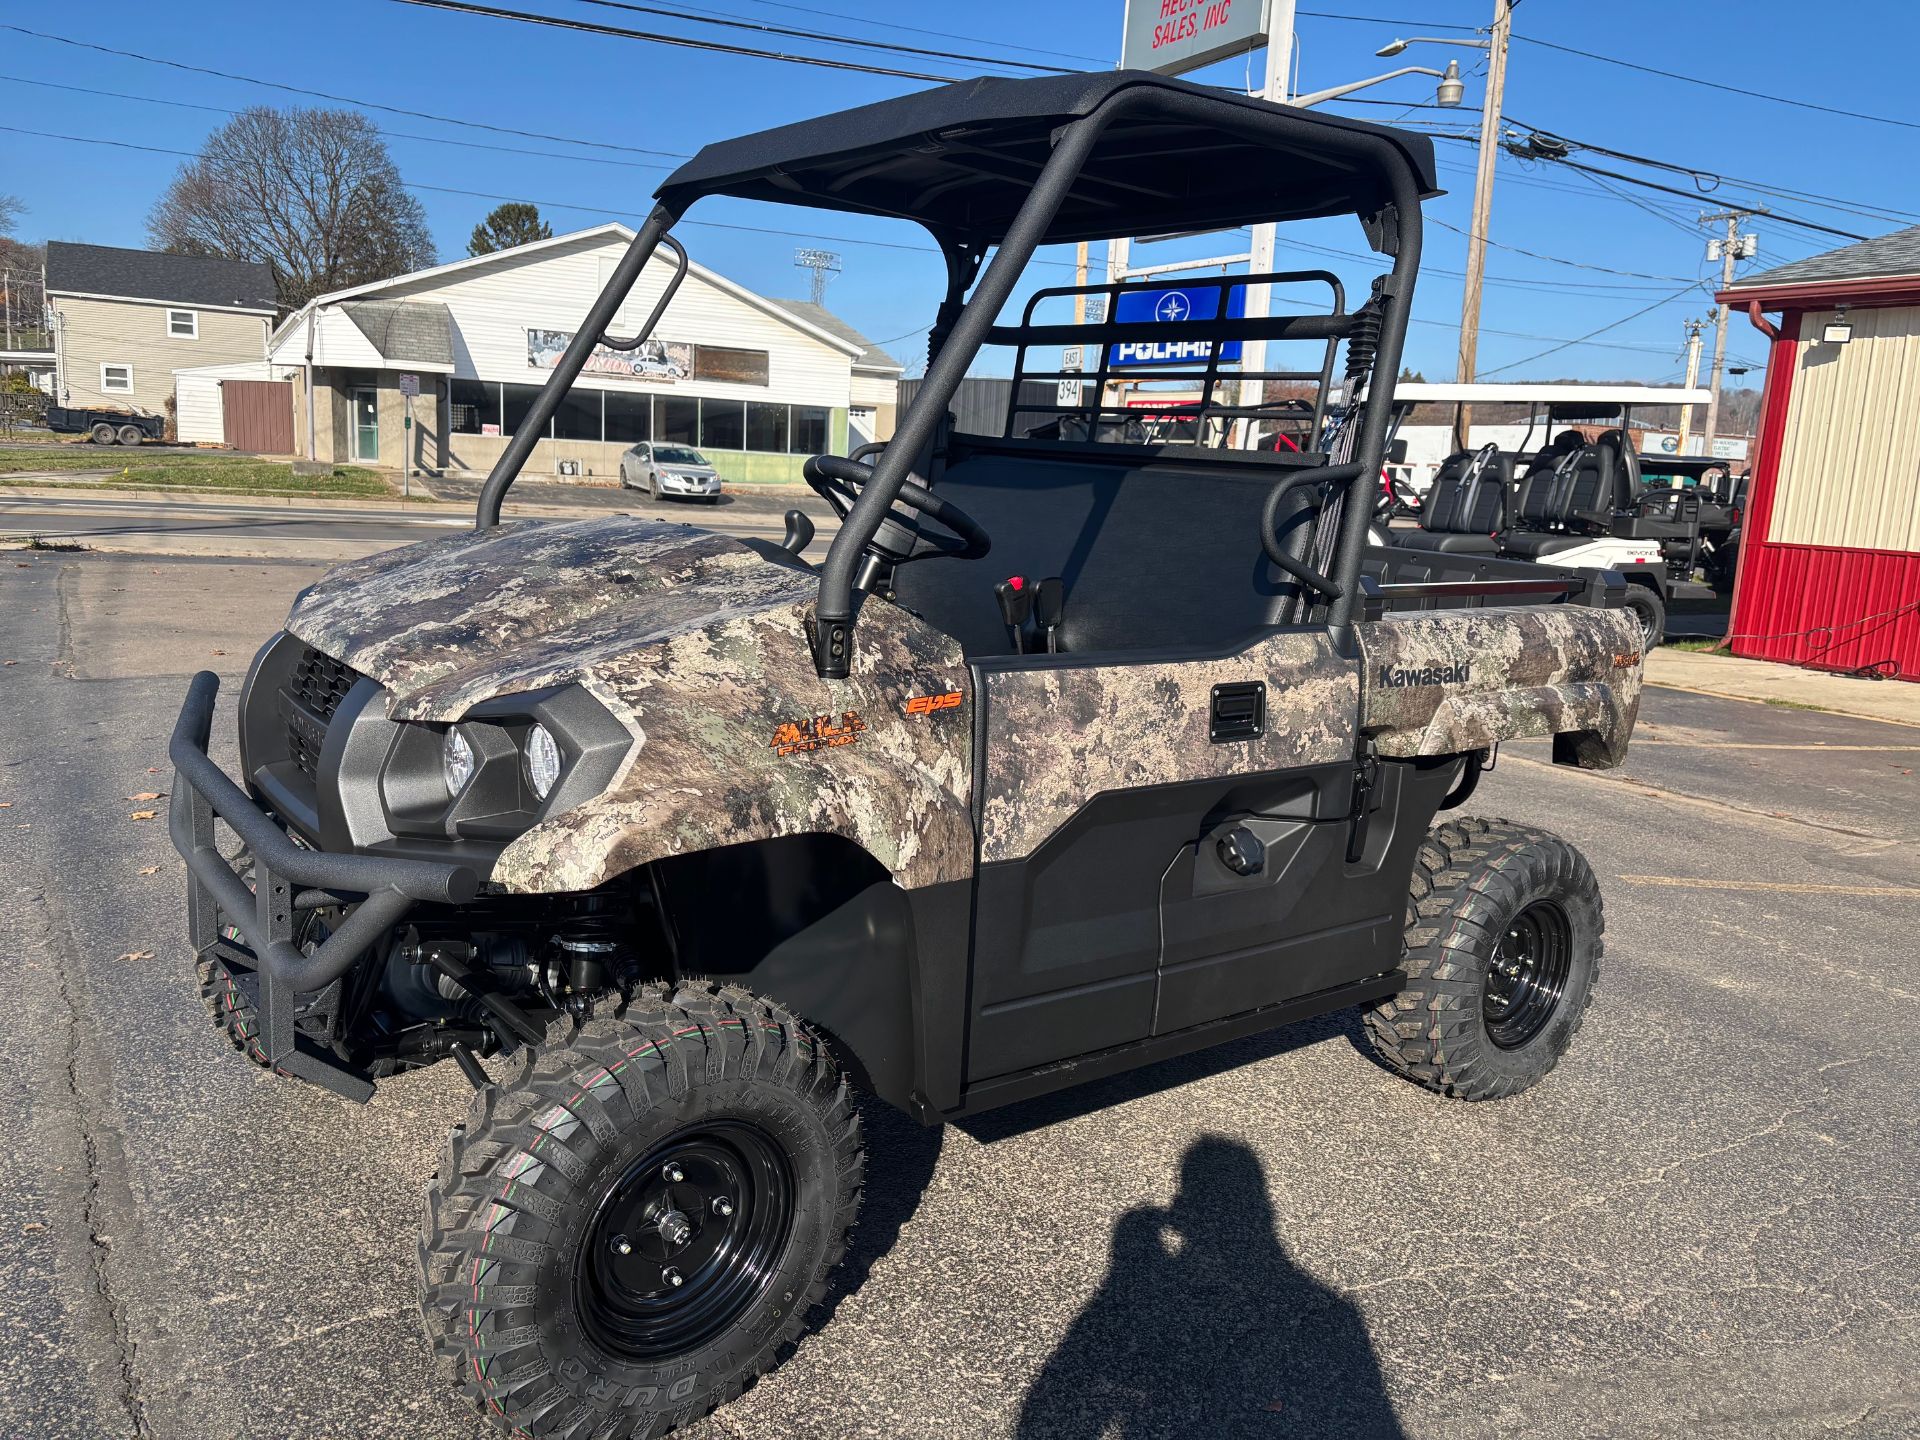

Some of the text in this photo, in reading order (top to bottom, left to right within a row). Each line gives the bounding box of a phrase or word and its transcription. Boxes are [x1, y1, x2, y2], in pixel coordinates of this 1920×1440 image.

[1152, 0, 1231, 49] SALES, INC
[1065, 351, 1079, 366] EAST
[1059, 380, 1078, 400] 394
[1379, 659, 1470, 689] Kawasaki
[769, 710, 867, 748] MULE
[558, 1354, 699, 1408] DURO
